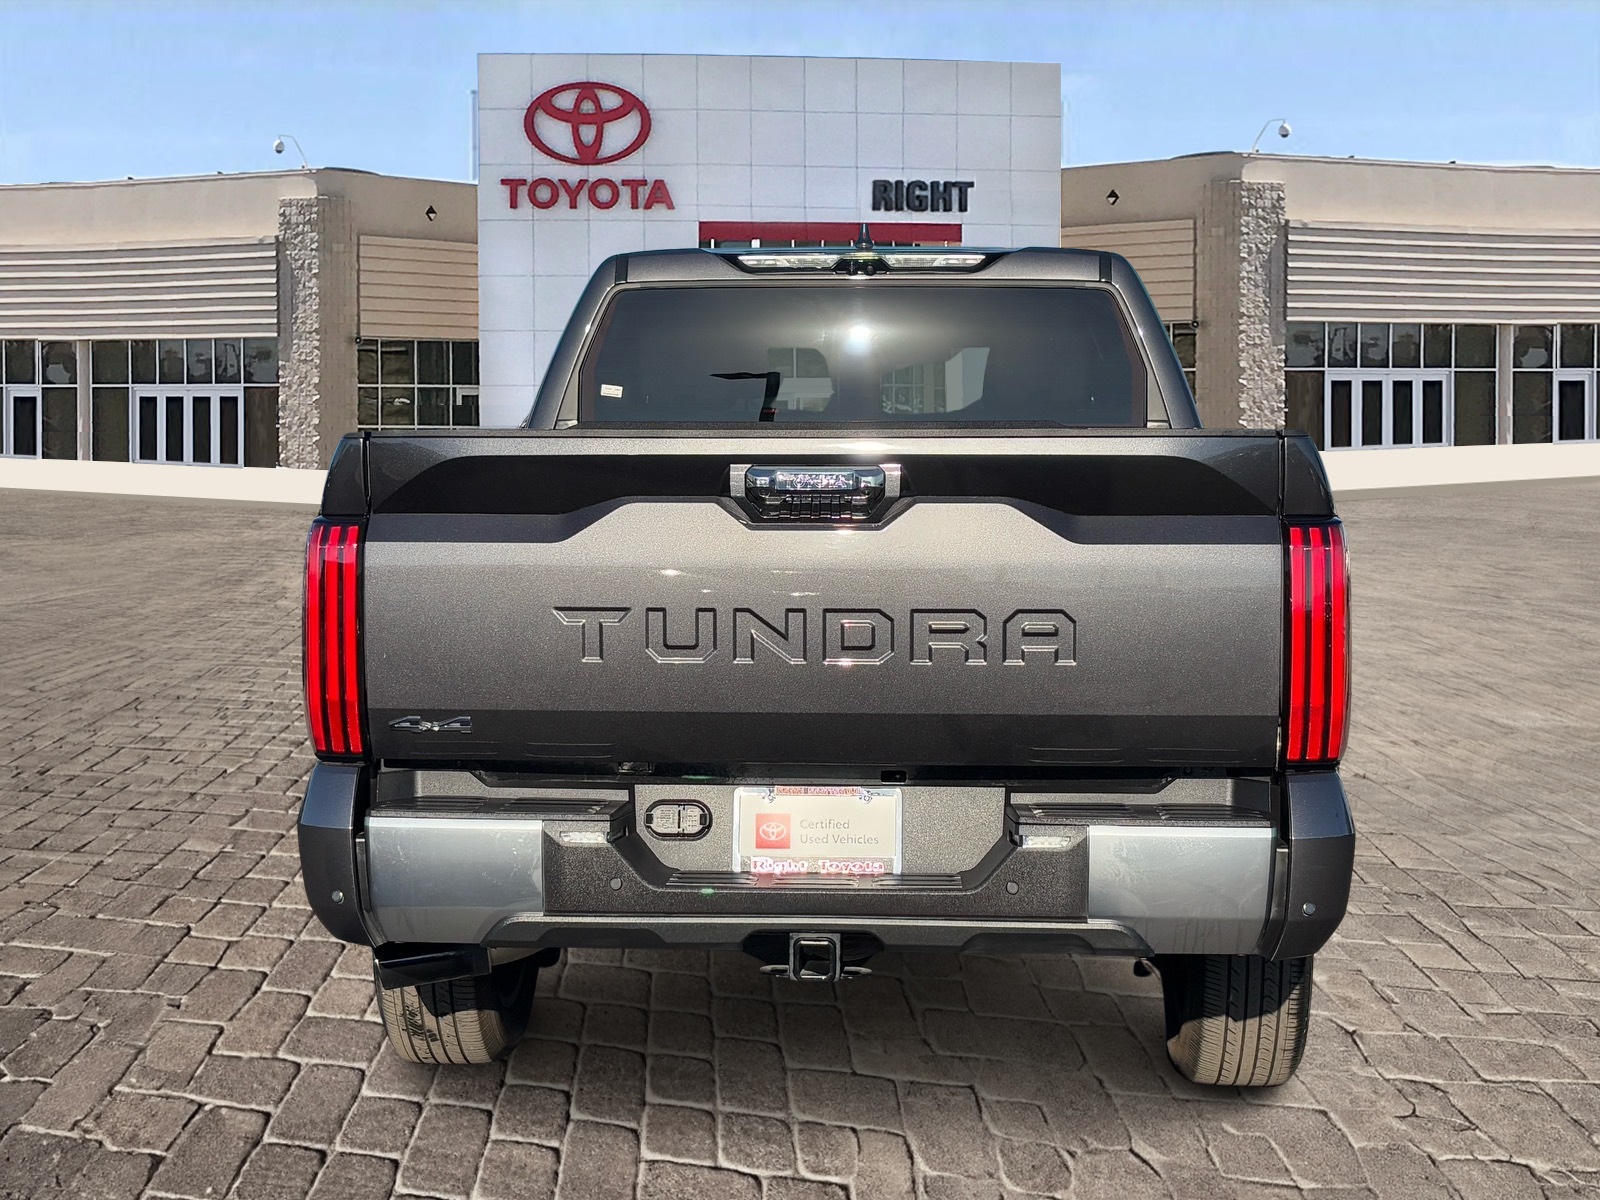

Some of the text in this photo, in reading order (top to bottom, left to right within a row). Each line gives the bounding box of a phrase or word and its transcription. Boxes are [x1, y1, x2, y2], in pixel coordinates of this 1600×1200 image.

[500, 178, 675, 210] TOYOTA
[871, 180, 975, 213] RIGHT
[552, 607, 1077, 666] TUNDRA
[799, 818, 850, 829] Certified
[799, 833, 879, 845] Used Vehicles
[751, 857, 885, 875] Right Toyota
